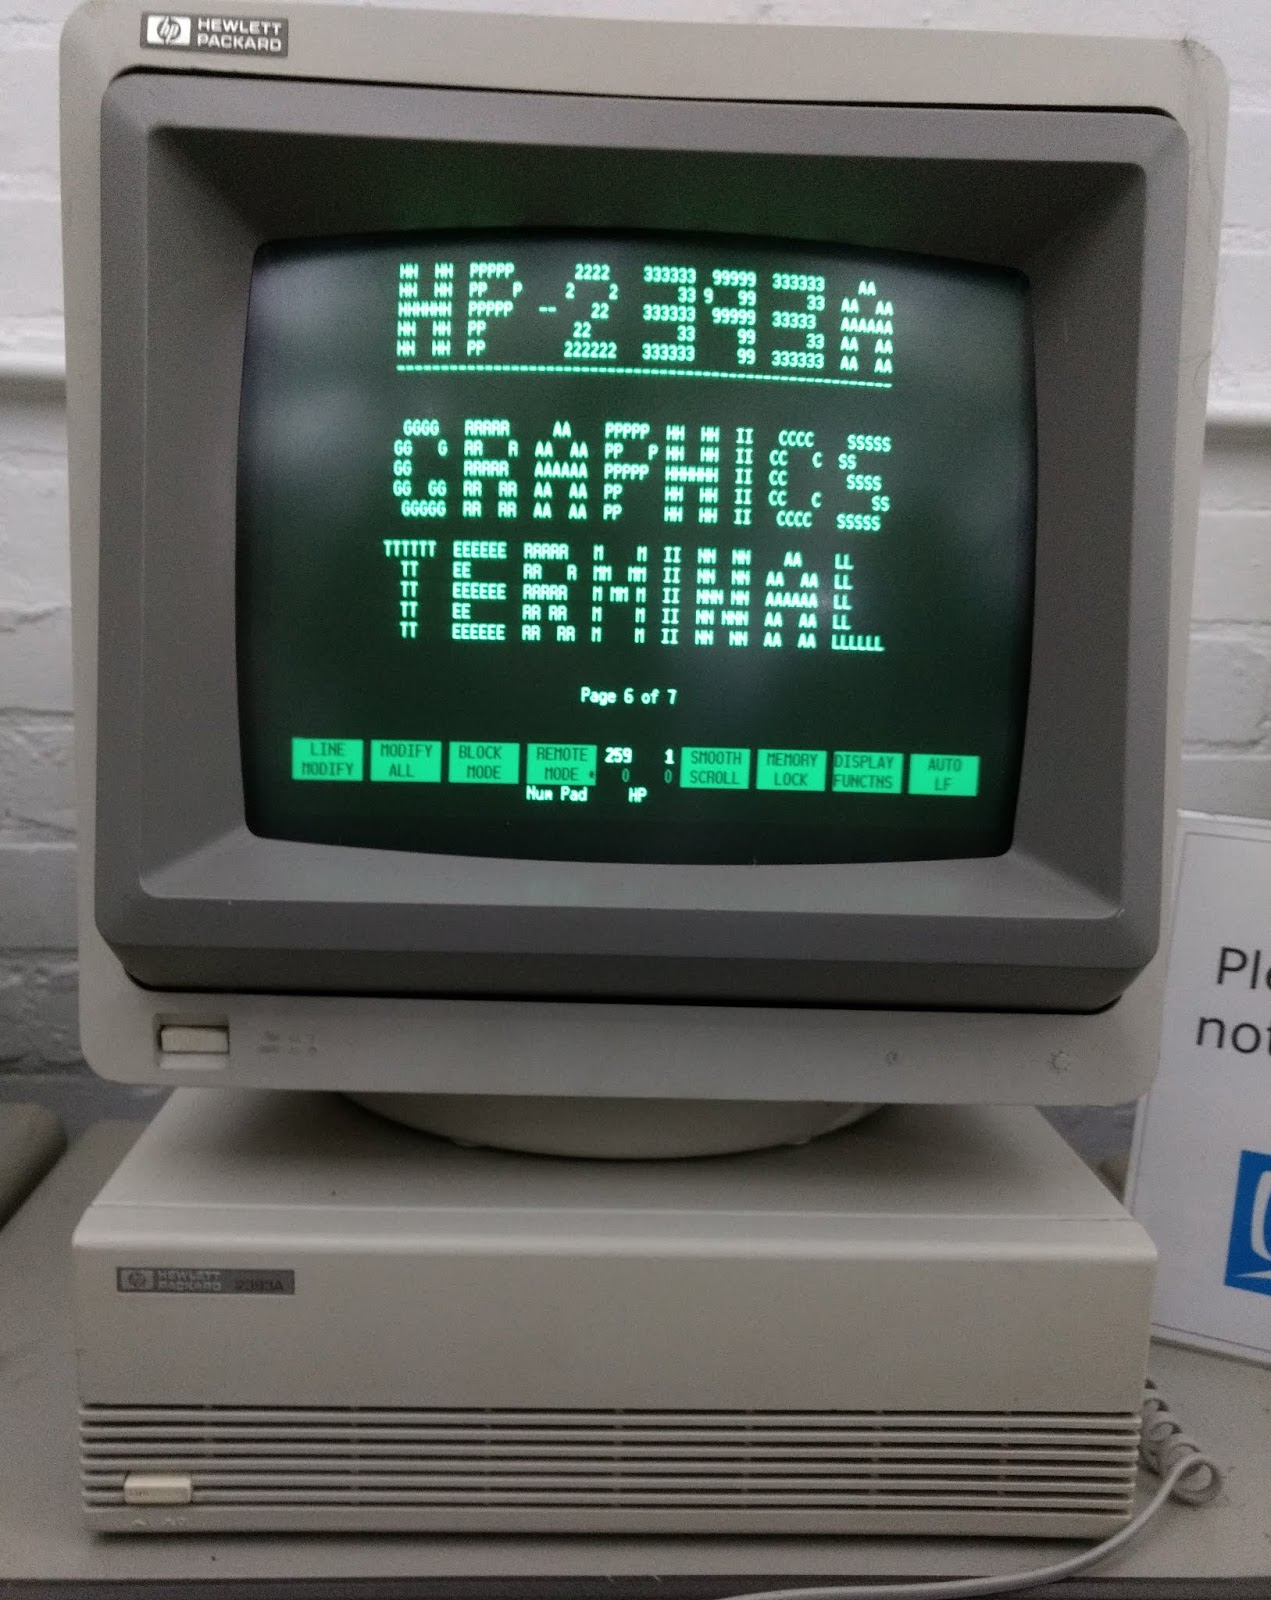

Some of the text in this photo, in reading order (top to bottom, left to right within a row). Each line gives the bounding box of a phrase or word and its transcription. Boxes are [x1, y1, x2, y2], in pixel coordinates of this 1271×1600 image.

[198, 18, 282, 35] HEWLETT
[198, 33, 282, 52] PACKARD
[580, 686, 678, 706] Page 6 of 7
[310, 742, 346, 757] LINE
[380, 743, 432, 758] MODIFY
[459, 745, 502, 760] BLOCK
[537, 747, 588, 762] REMOTE
[604, 747, 632, 763] 259
[664, 749, 675, 764] 1
[691, 750, 742, 766] SMOOTH
[766, 752, 818, 767] MEMORY
[833, 754, 894, 769] DISPLAY
[928, 757, 963, 772] AUTO
[301, 763, 354, 777] MODIFY
[389, 764, 415, 778] ALL
[467, 765, 501, 779] MODE
[545, 767, 579, 781] MODE
[690, 770, 740, 785] SCROLL
[774, 772, 808, 787] LOCK
[832, 774, 893, 789] FUNCTNS
[934, 777, 952, 791] LF
[526, 785, 588, 801] Num Pad
[628, 787, 648, 803] HP
